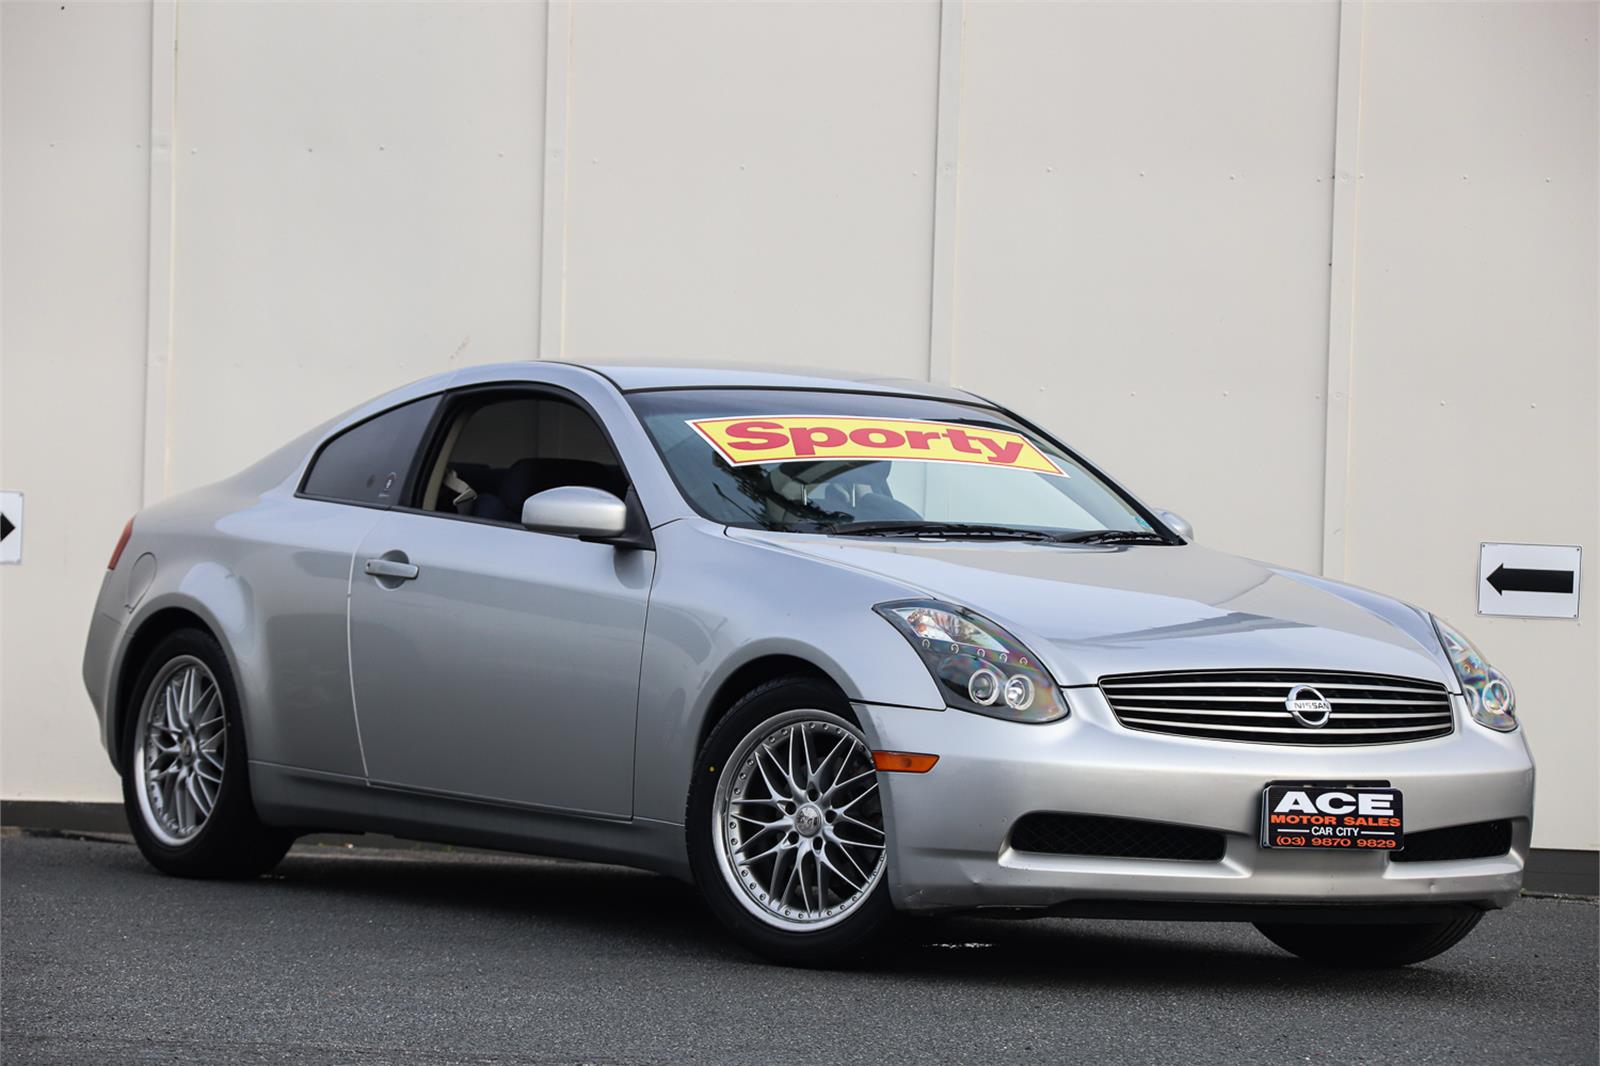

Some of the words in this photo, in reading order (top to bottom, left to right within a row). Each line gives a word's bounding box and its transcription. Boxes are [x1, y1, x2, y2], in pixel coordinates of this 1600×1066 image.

[725, 421, 1024, 463] Sporty
[1293, 702, 1330, 710] NISSAN
[1273, 791, 1394, 816] ACE
[1270, 815, 1337, 826] MOTOR
[1343, 817, 1401, 827] SALES
[1311, 826, 1333, 836] CAR
[1336, 827, 1360, 837] CITY
[1276, 836, 1306, 847] (03)
[1311, 838, 1352, 847] 9870
[1356, 839, 1396, 848] 9829
